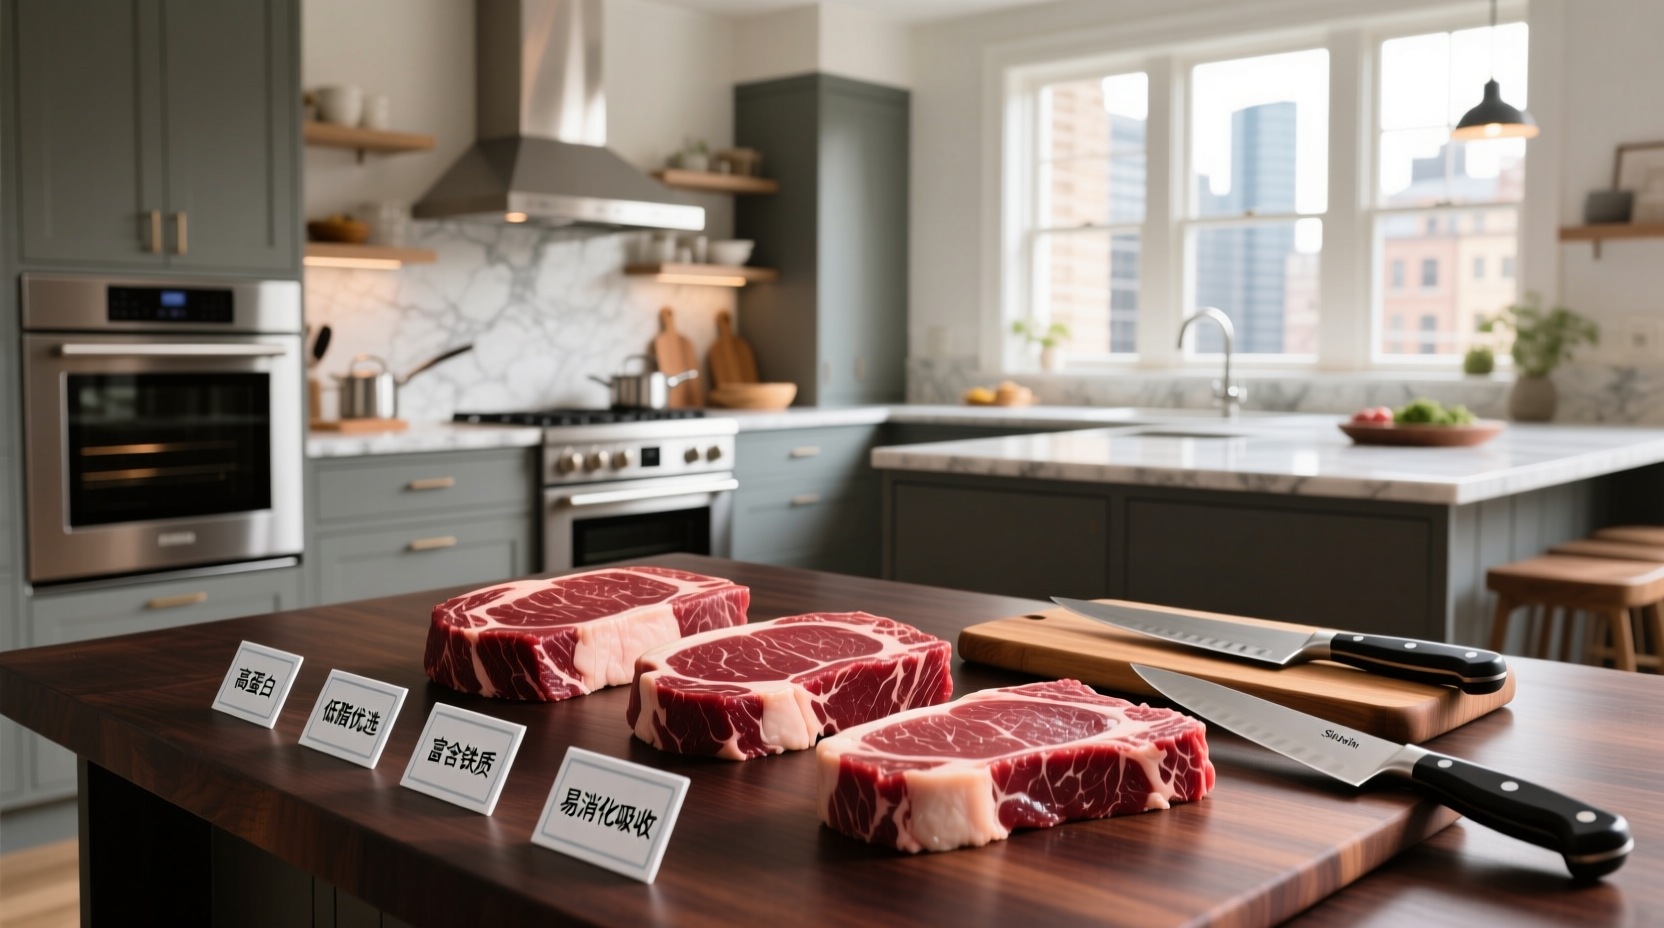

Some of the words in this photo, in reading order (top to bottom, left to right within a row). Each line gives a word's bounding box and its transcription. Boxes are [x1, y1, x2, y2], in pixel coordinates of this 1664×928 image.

[234, 667, 276, 699] 高蛋白
[322, 699, 381, 736] 低脂优选
[427, 737, 496, 777] 富含铁质
[560, 788, 657, 839] 易消化吸收
